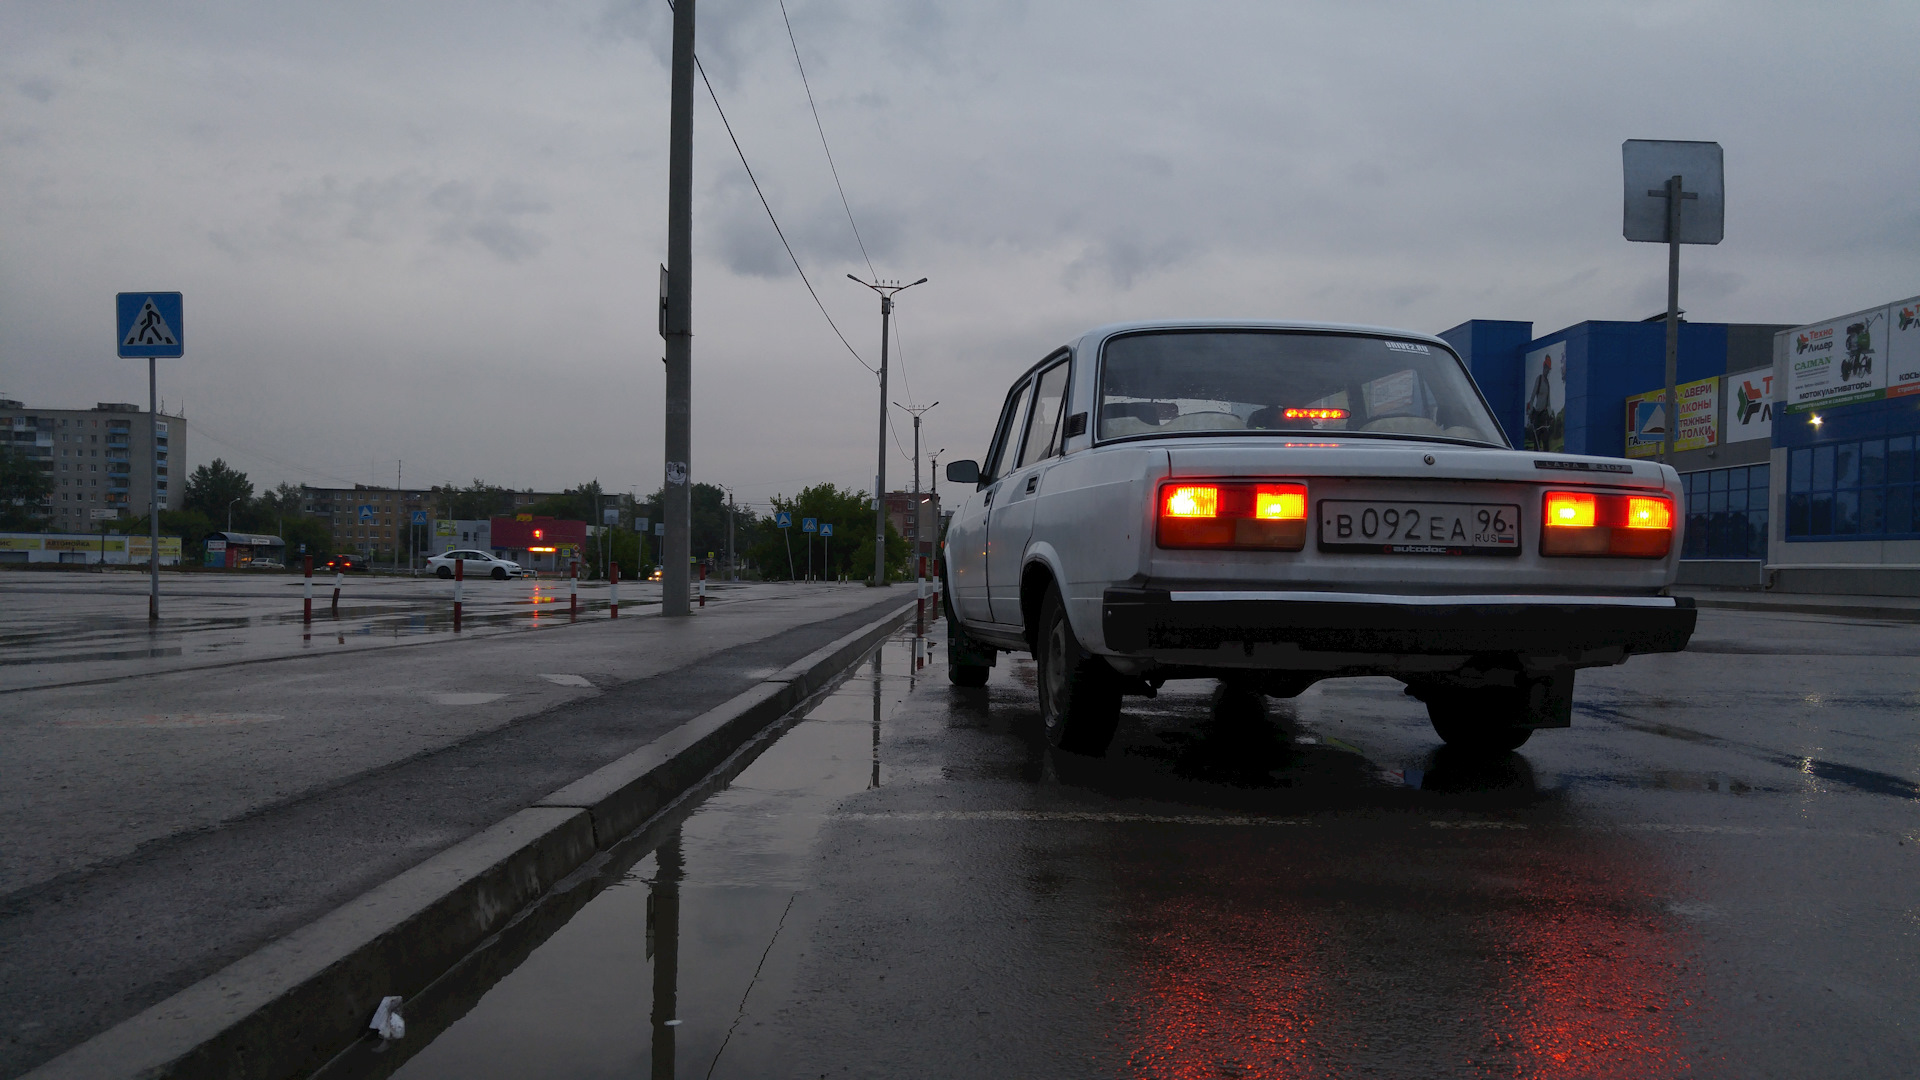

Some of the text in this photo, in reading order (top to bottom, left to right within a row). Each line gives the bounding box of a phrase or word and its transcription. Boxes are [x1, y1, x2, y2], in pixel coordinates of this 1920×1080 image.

[1809, 328, 1833, 340] Техно
[1385, 341, 1429, 353] DRIVE2.RU
[1808, 341, 1833, 353] Лидер
[1794, 356, 1832, 371] CAIMAN
[1684, 383, 1712, 399] ДВЕРИ
[1799, 381, 1872, 400] мотокультиваторы
[1545, 461, 1623, 471] LADA 2107
[1478, 509, 1507, 533] 96
[1475, 533, 1497, 543] RUS
